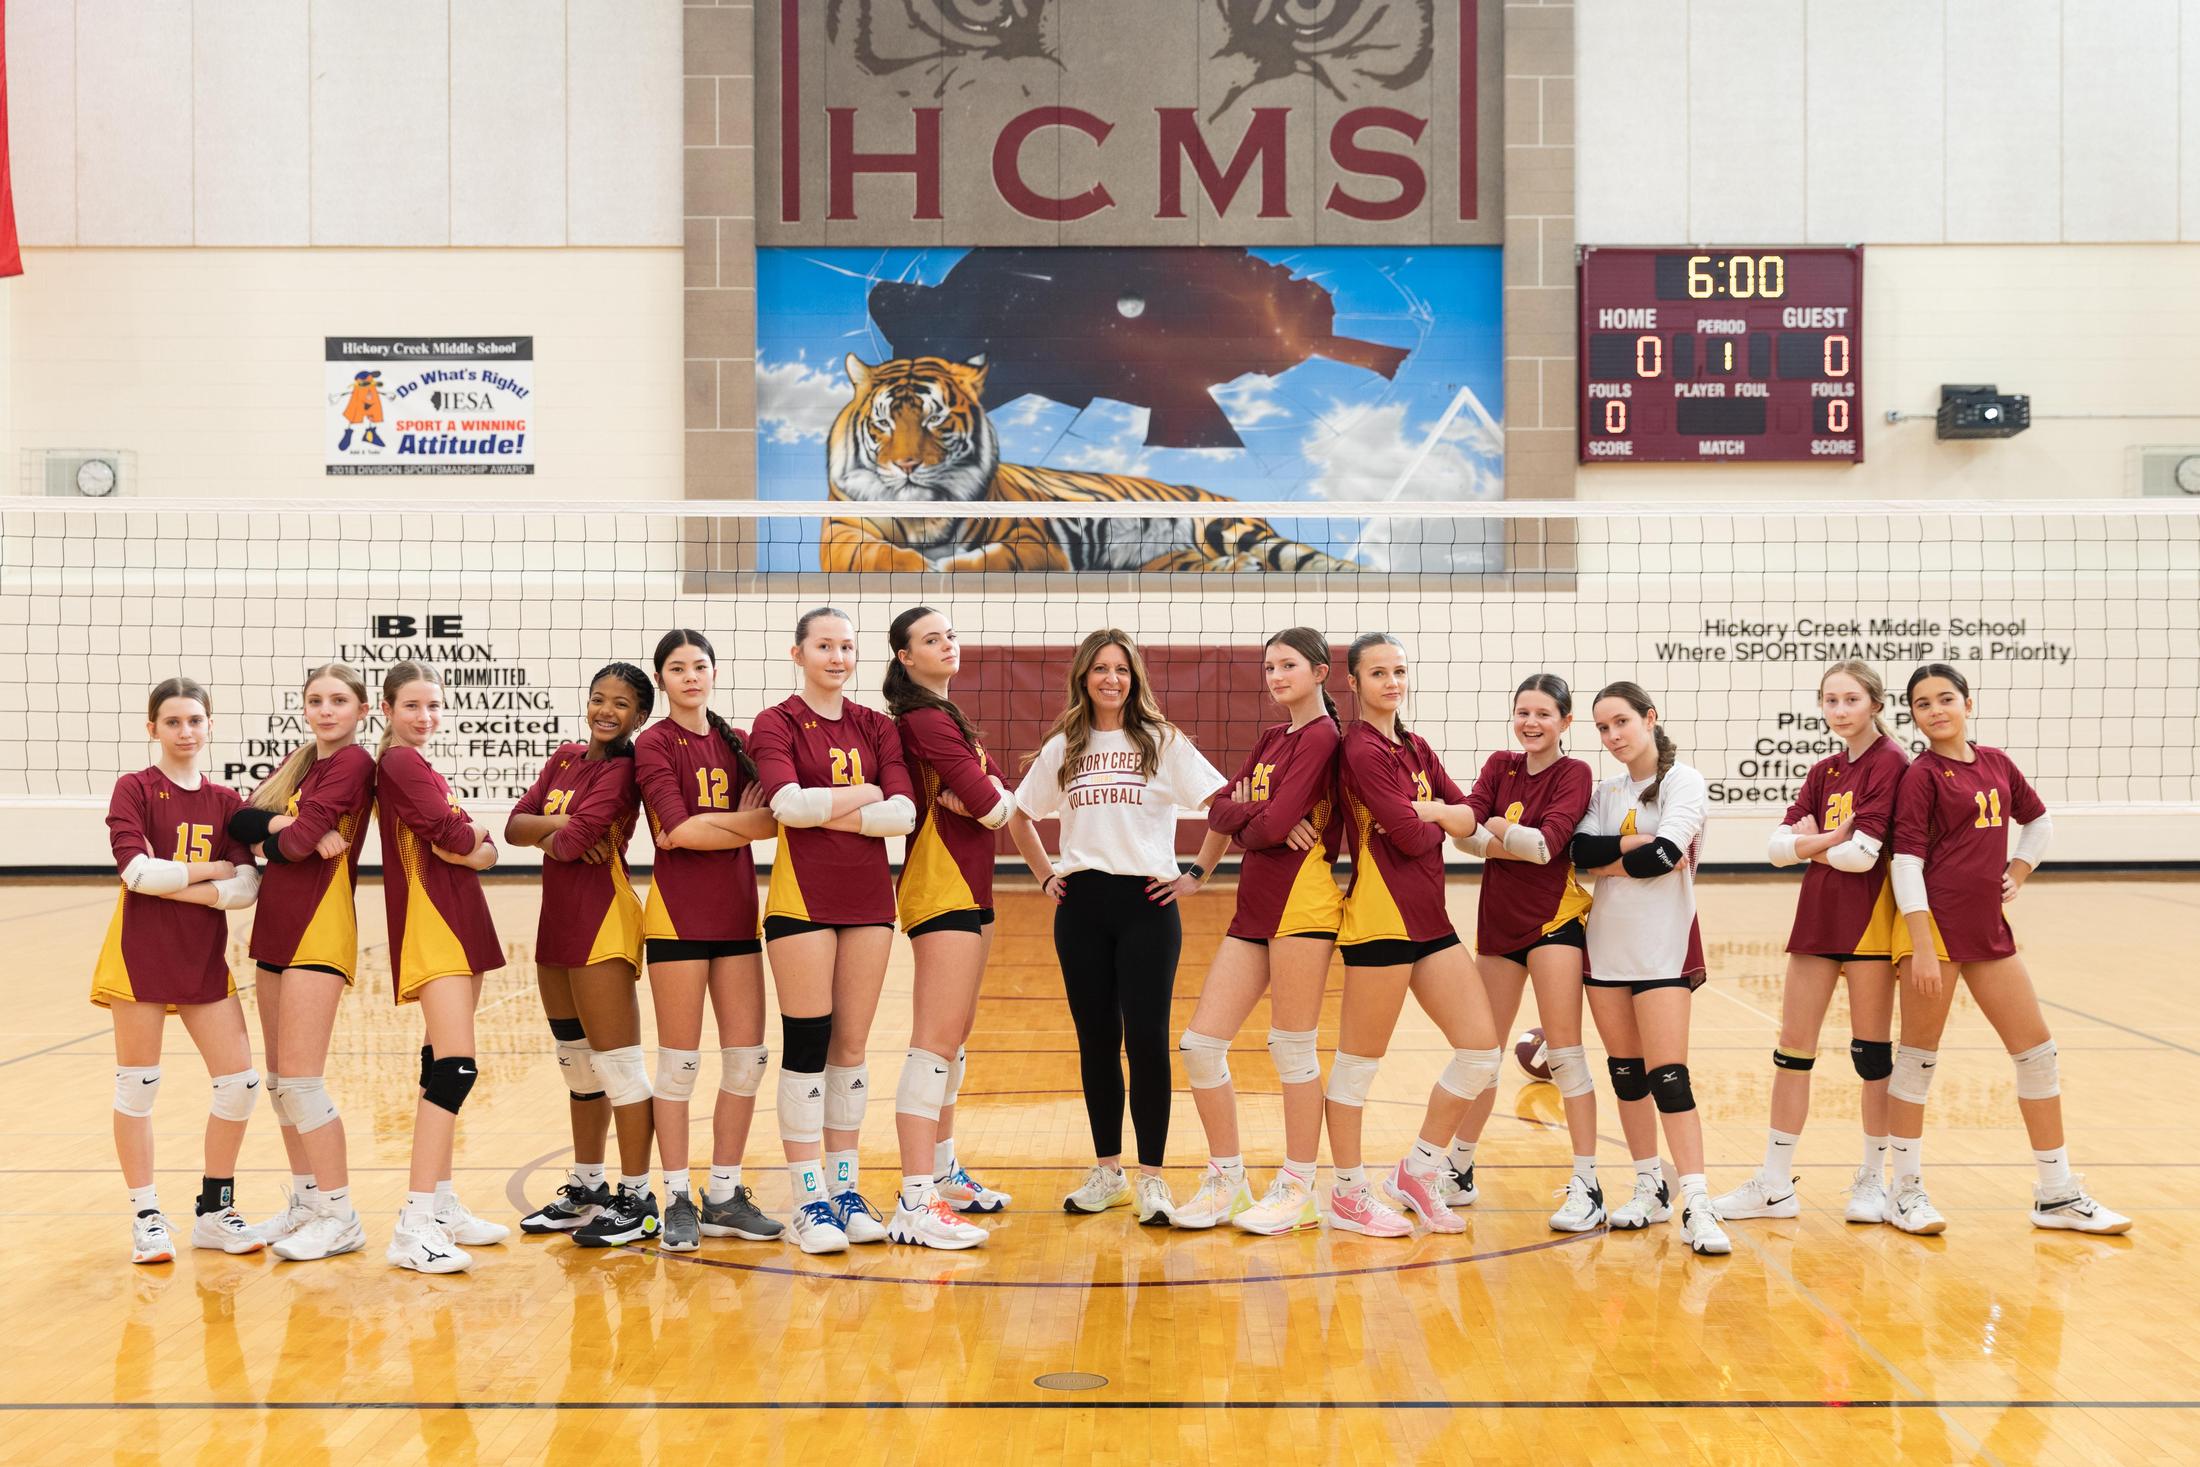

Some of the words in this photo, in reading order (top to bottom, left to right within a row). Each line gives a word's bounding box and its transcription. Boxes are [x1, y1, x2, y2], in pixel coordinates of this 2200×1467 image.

[825, 106, 1431, 221] HCMS
[1688, 255, 1784, 299] 6:00
[1599, 309, 1657, 329] HOME
[1697, 319, 1746, 334] PERIOD
[1783, 307, 1848, 329] GUEST
[342, 342, 390, 357] Hickory
[393, 342, 430, 355] Creek
[432, 342, 474, 355] Middle
[477, 342, 517, 354] School
[1636, 335, 1662, 378] 0
[1724, 341, 1733, 371] 1
[1824, 335, 1850, 377] 0
[396, 381, 418, 399] Do
[420, 368, 477, 385] What's
[481, 370, 530, 399] Right!
[1588, 383, 1632, 398] FOULS
[1674, 383, 1725, 398] PLAYER
[1735, 383, 1770, 398] FOUL
[1811, 383, 1855, 397] FOULS
[443, 391, 495, 410] IESA
[396, 420, 443, 431] SPORT
[447, 420, 456, 431] A
[461, 420, 526, 431] WINNING
[1605, 400, 1626, 434] 0
[1828, 399, 1848, 433] 0
[398, 434, 525, 455] Attitude!
[1588, 441, 1633, 456] SCORE
[1699, 440, 1745, 455] MATCH
[1811, 440, 1855, 455] SCORE
[357, 466, 401, 475] DIVISION
[404, 465, 488, 474] SPORTSMANSHIP
[489, 465, 527, 474] AWARD
[372, 615, 463, 638] BE
[1704, 619, 1788, 642] Hickory
[1797, 618, 1861, 637] Creek
[1869, 618, 1940, 637] Middle
[1950, 618, 2026, 637] School
[340, 644, 497, 662] UNCOMMON.
[1656, 642, 1726, 661] Where
[1736, 642, 1933, 661] SPORTSMANSHIP
[1943, 642, 1960, 660] is
[1969, 646, 1981, 660] a
[1991, 642, 2071, 664] Priority
[444, 668, 531, 686] COMMITTED.
[829, 747, 865, 786] 21
[695, 767, 730, 809] 12
[1251, 762, 1276, 801] 25
[1068, 787, 1143, 810] VOLLEYBALL
[1974, 788, 2002, 829] 11
[172, 822, 214, 863] 15
